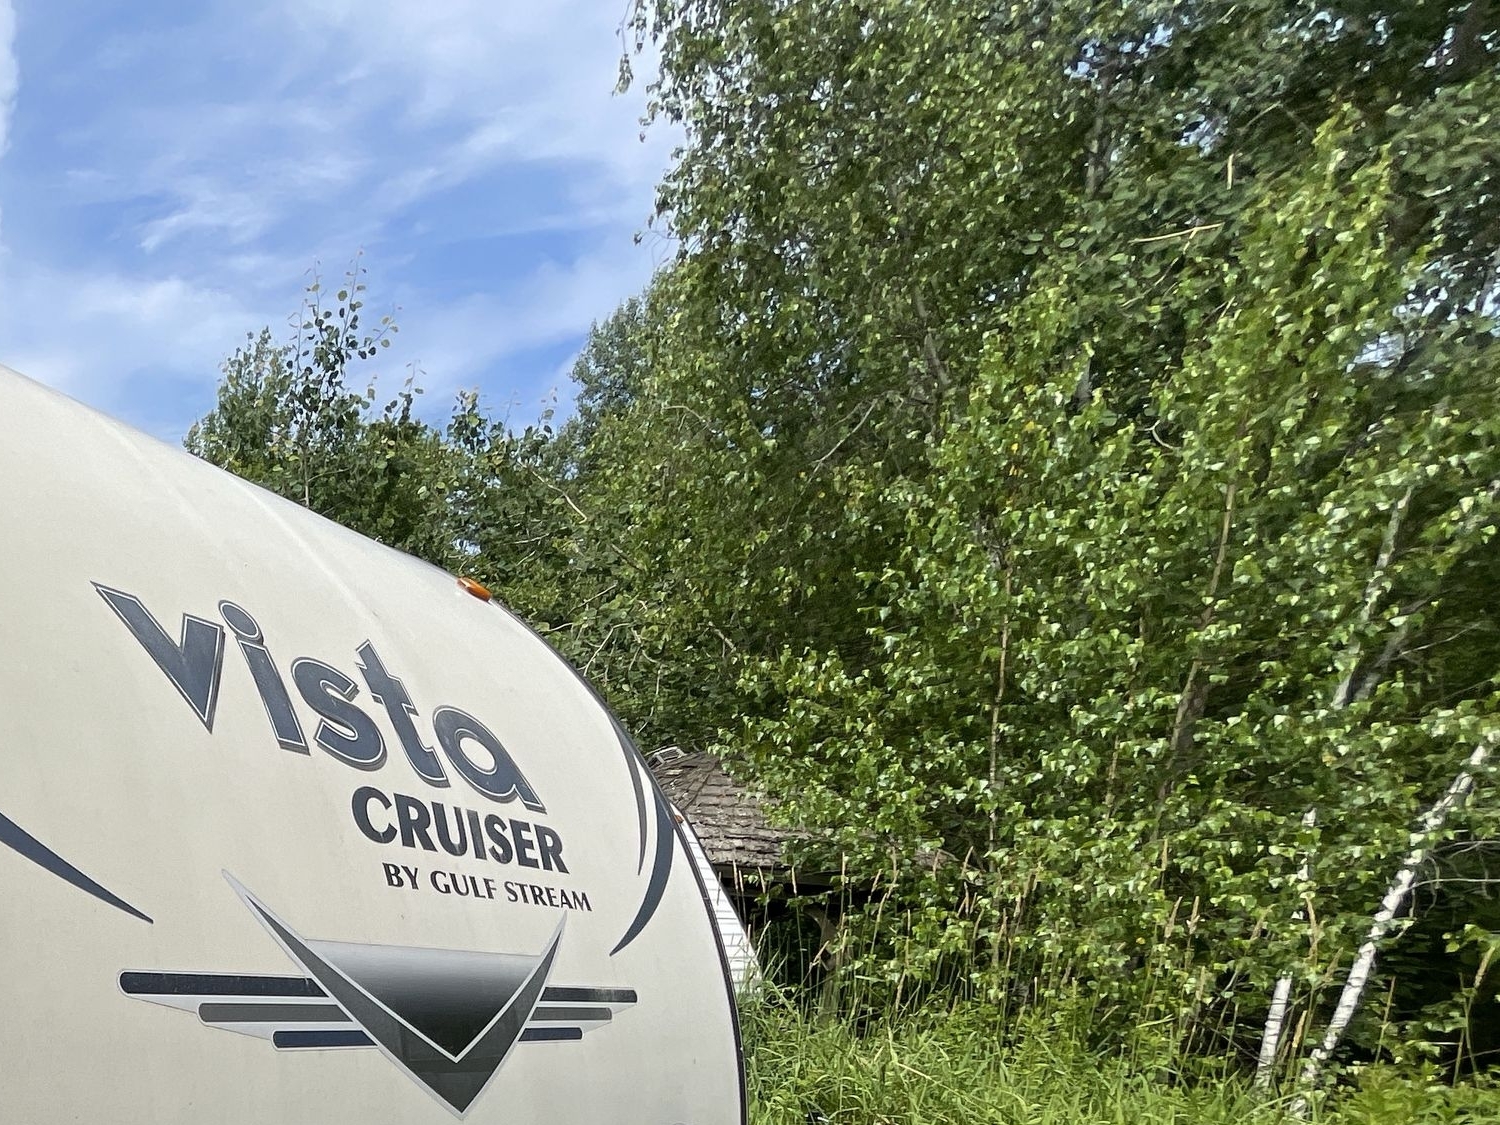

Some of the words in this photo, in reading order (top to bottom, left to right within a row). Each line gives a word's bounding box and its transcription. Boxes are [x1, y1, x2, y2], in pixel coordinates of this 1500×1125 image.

[351, 786, 570, 874] CRUISER
[382, 862, 419, 890] BY
[430, 871, 497, 899] GULF
[504, 881, 592, 912] STREAM
